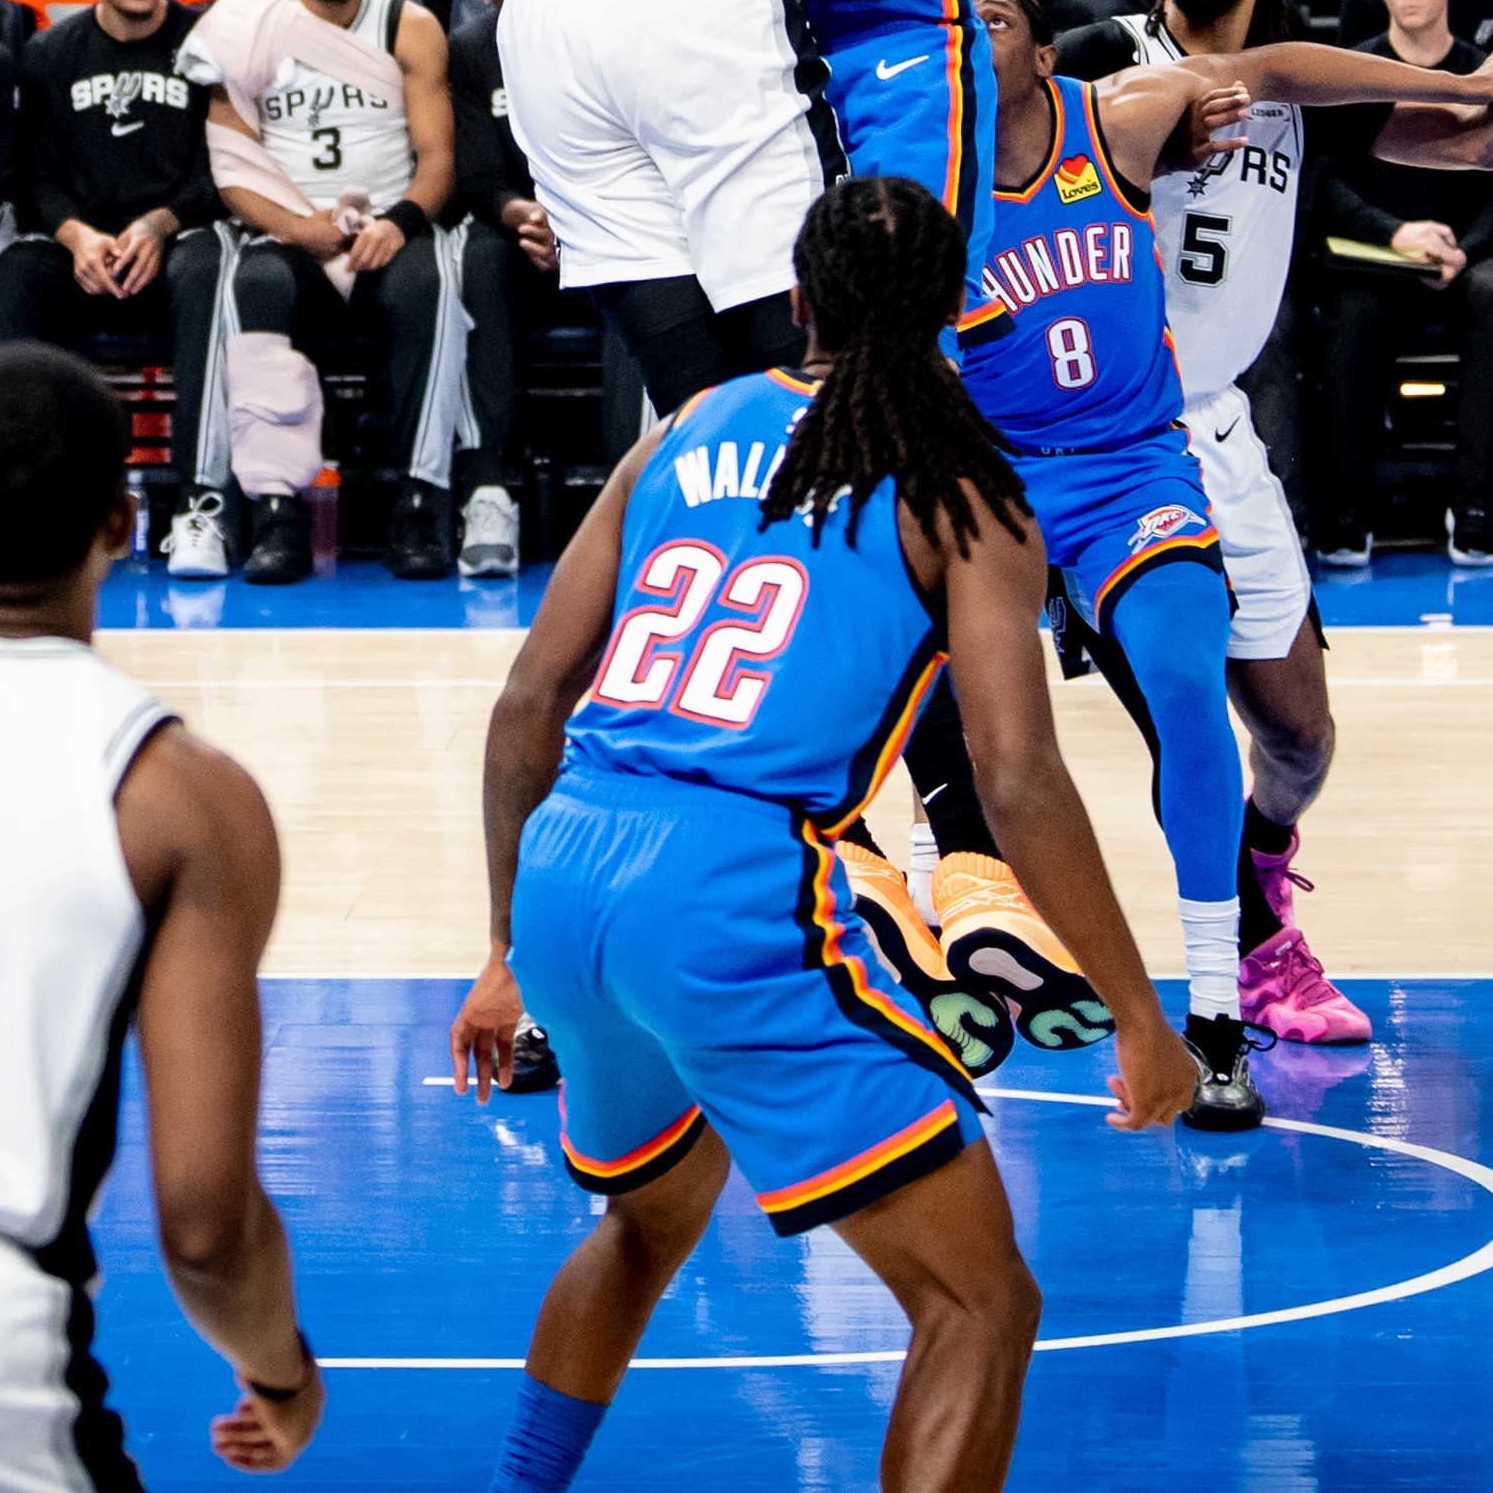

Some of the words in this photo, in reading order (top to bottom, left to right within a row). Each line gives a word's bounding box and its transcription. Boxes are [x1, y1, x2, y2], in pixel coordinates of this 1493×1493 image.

[70, 71, 190, 115] SPURS
[311, 126, 342, 172] 3
[982, 222, 1134, 315] HUNDER
[1179, 210, 1232, 287] 5
[1046, 317, 1098, 391] 8
[598, 538, 810, 729] 22
